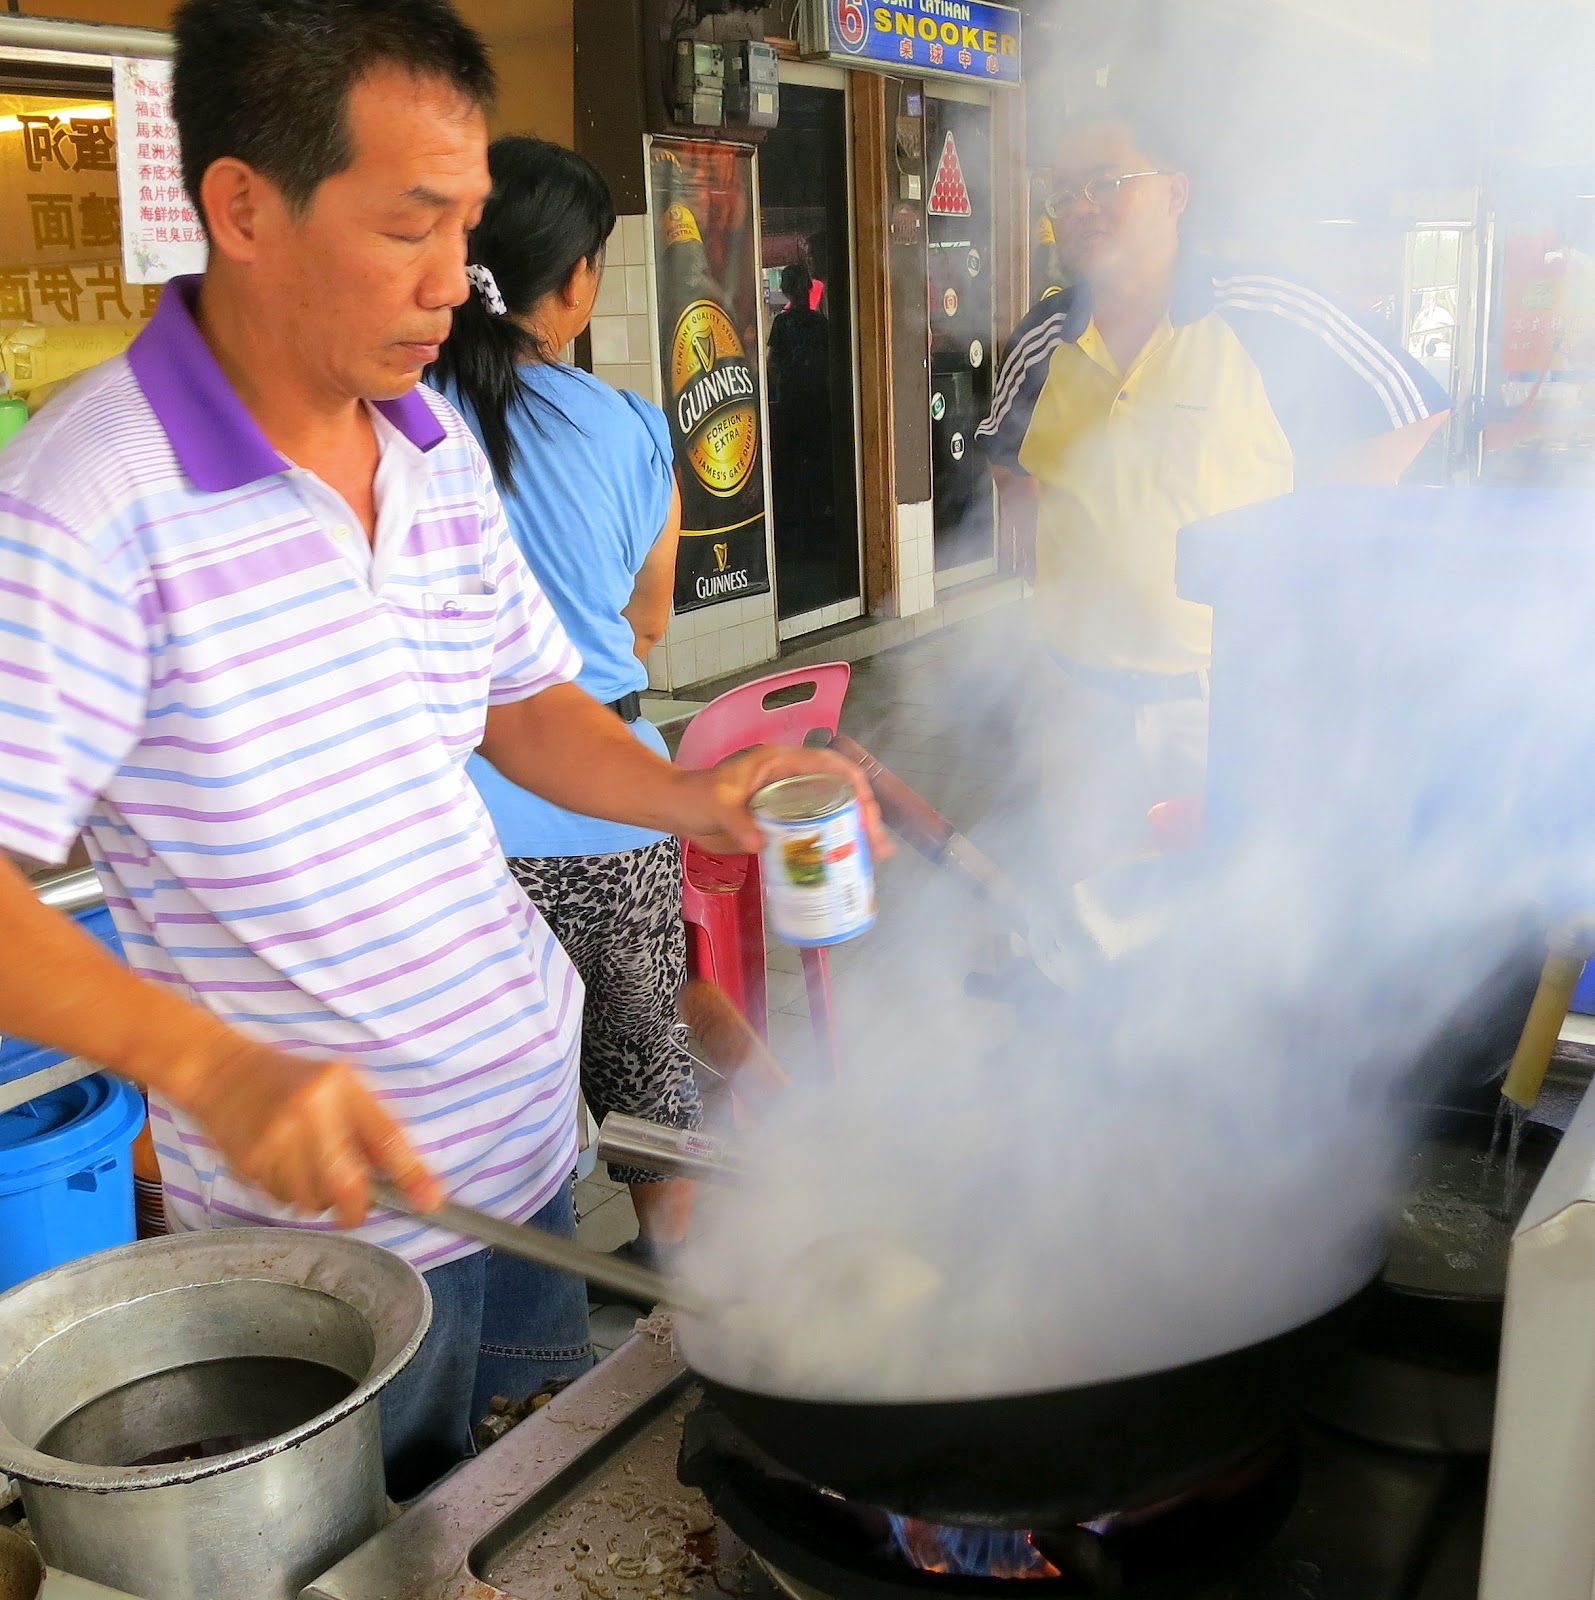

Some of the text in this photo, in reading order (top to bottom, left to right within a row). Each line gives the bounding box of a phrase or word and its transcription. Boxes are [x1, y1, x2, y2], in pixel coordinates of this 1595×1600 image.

[920, 0, 970, 21] LATIHAN
[873, 7, 1017, 57] SNOOKER
[899, 37, 1000, 74] 桌球中心
[676, 324, 691, 375] GENUINE
[691, 312, 720, 324] QUALITY
[678, 365, 754, 434] GUINNESS
[706, 413, 742, 444] FOREIGN
[714, 428, 740, 453] EXTRA
[698, 458, 727, 481] JAMES'S
[729, 458, 746, 479] GATE
[742, 415, 753, 457] DUBLIN
[695, 569, 748, 599] GUINNESS
